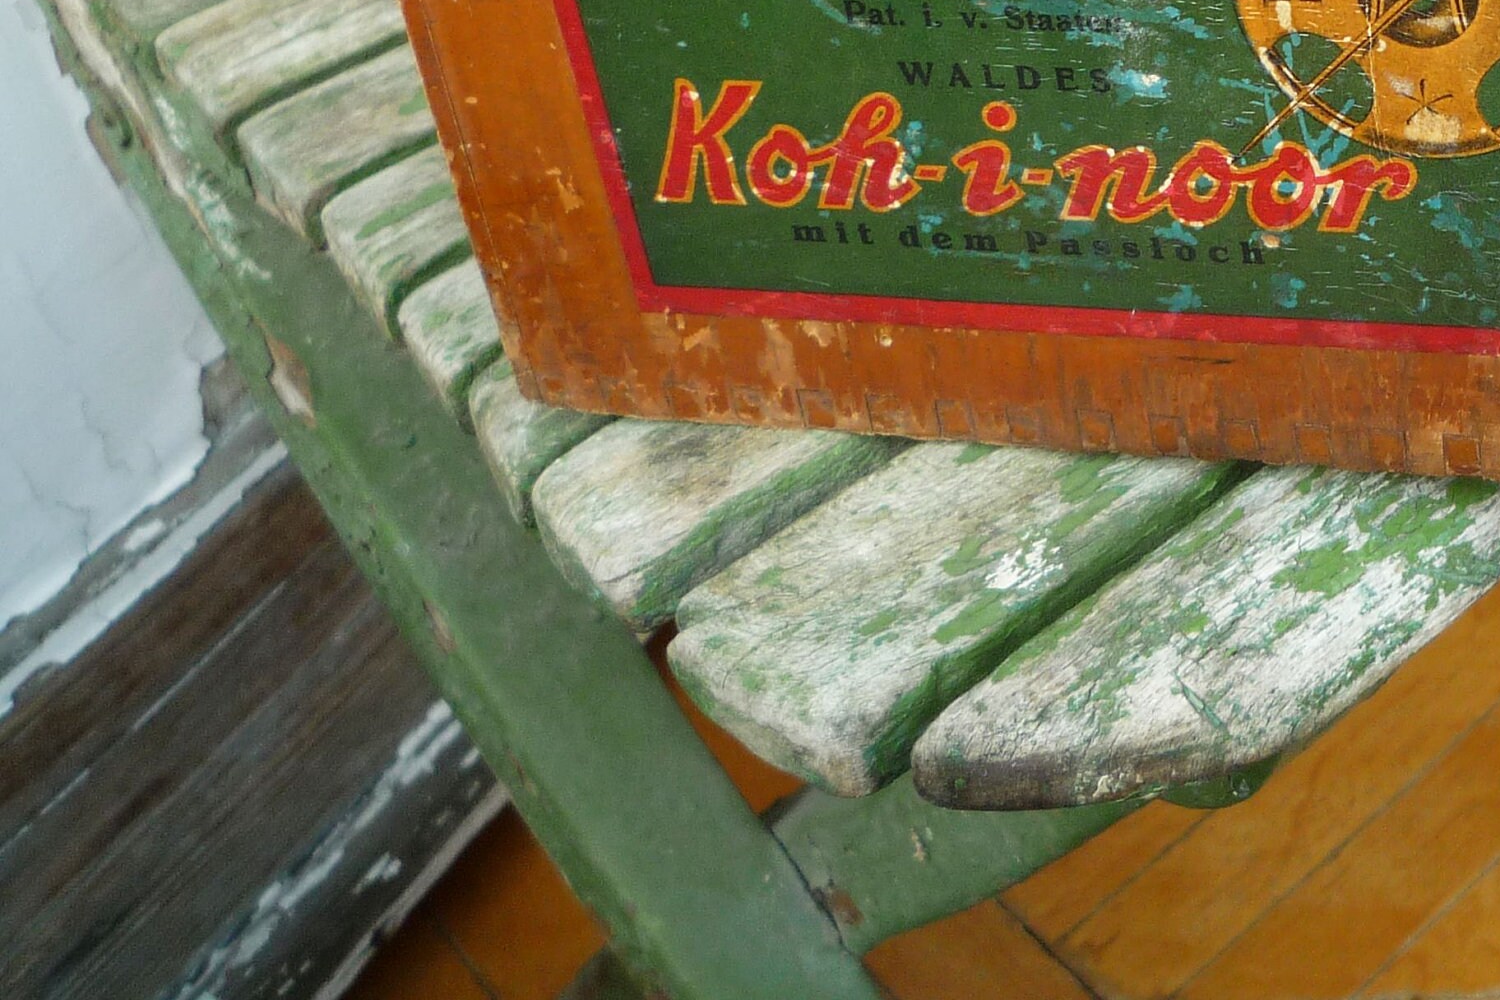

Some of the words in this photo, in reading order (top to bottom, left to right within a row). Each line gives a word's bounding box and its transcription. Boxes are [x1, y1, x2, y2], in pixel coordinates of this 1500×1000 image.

[844, 0, 904, 27] Pat.
[960, 10, 988, 29] v.
[897, 60, 1112, 93] WALDES
[654, 74, 1418, 233] Koh-i-noor
[792, 221, 875, 245] mit
[898, 224, 999, 251] dem
[1024, 230, 1266, 264] Passloch
